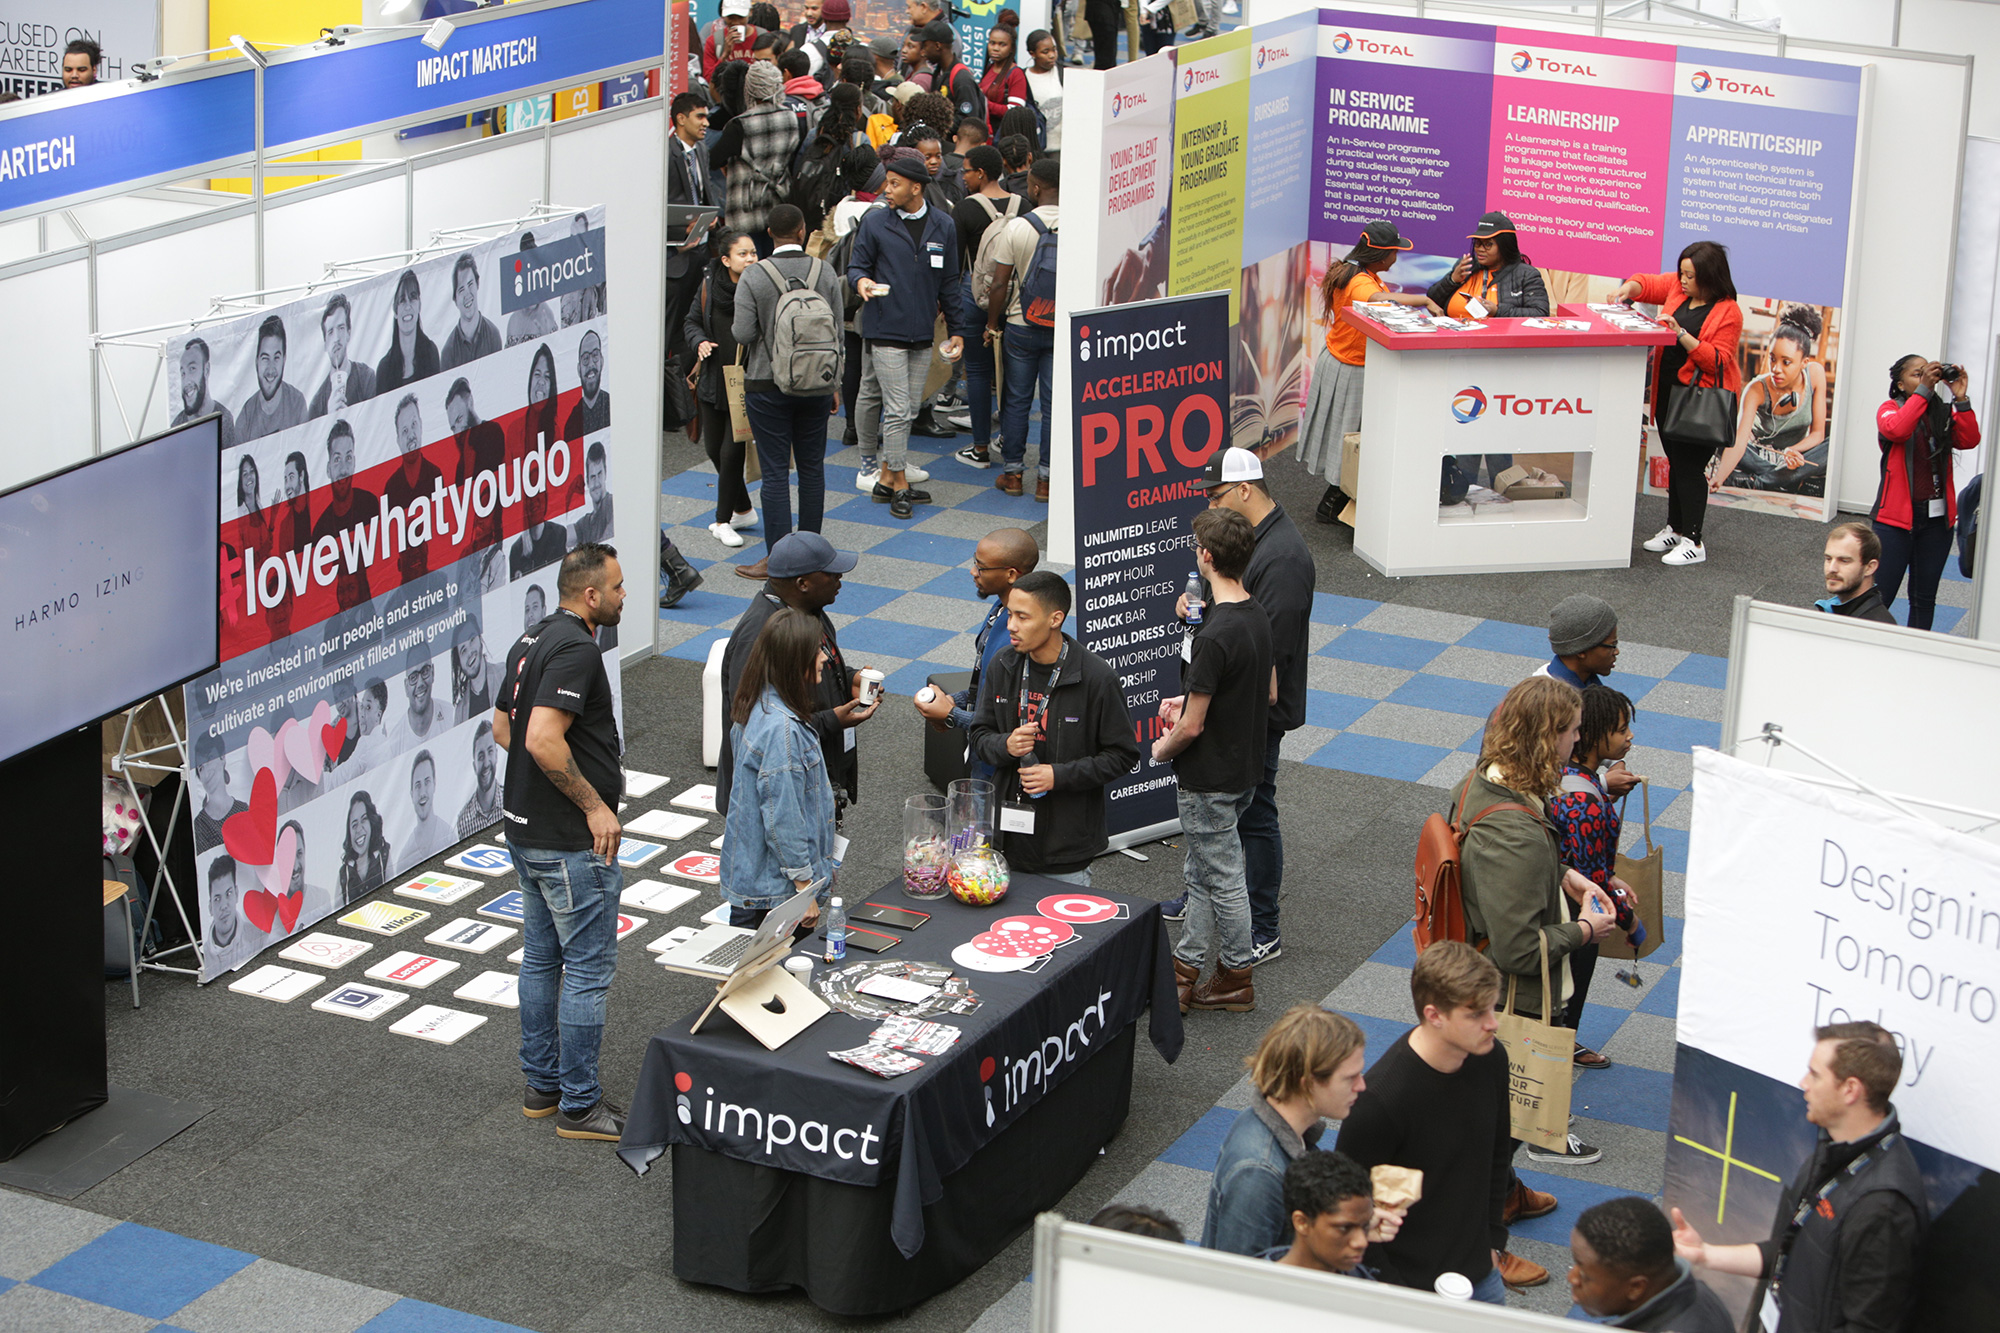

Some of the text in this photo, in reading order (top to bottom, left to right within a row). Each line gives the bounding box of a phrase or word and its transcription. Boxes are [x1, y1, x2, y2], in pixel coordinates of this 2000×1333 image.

[1267, 48, 1289, 62] TOTAL
[1356, 38, 1414, 58] TOTAL
[417, 36, 537, 88] IMPACT MARTECH
[1535, 57, 1597, 78] TOTAL
[1195, 69, 1220, 84] TOTAL
[1715, 77, 1775, 99] TOTAL
[1123, 92, 1147, 109] TOTAL
[1254, 96, 1290, 122] BURSARIES
[1329, 88, 1414, 113] IN SERVICE
[1328, 107, 1429, 135] PROGRAMME
[1507, 104, 1620, 133] LEARNERSHIP
[1181, 120, 1228, 150] INTERNSHIP &
[1341, 137, 1441, 155] In-Service programme
[1515, 134, 1627, 156] Learnership training
[1685, 125, 1823, 157] APPRENTICESHIP
[1110, 137, 1158, 170] YOUNG TALENT
[1181, 136, 1239, 171] YOUNG GRADUATE
[1336, 150, 1450, 167] practical work experience
[1504, 146, 1628, 165] programme that facilitates
[1699, 155, 1804, 175] Apprenticeship system
[1109, 159, 1156, 194] DEVELOPMENT
[1179, 161, 1228, 193] PROGRAMMES
[1325, 169, 1413, 186] two years theory.
[1326, 158, 1444, 178] during studies usually after
[1503, 165, 1642, 190] learning and work experience
[1504, 155, 1646, 179] the linkage between structured
[1325, 179, 1440, 199] Essential work experience
[1513, 179, 1617, 198] order for the individual
[1683, 178, 1821, 200] system that incorporates both
[1692, 168, 1823, 192] well known technical training
[1108, 181, 1155, 216] PROGRAMMES
[1324, 190, 1454, 212] that part the qualification
[1502, 190, 1651, 213] acquire registered qualification.
[1682, 188, 1810, 210] the theoretical and practical
[1323, 212, 1337, 220] the
[1324, 202, 1437, 221] and necessary achieve
[1680, 210, 1809, 233] trades achieve Artisan
[1681, 201, 1833, 225] components offered designated
[1508, 212, 1654, 236] combines theory and workplace
[1539, 227, 1556, 236] into
[1565, 230, 1621, 244] qualification.
[1680, 222, 1710, 232] status.
[526, 246, 593, 294] impact
[1096, 320, 1187, 360] impact
[1081, 360, 1223, 403] ACCELERATION
[1493, 394, 1592, 416] TOTAL
[1081, 393, 1224, 488] PRO
[1084, 516, 1178, 548] UNLIMITED LEAVE
[1084, 543, 1156, 569] BOTTOMLESS
[1085, 564, 1155, 591] HAPPY HOUR
[1085, 580, 1175, 612] GLOBAL OFFICES
[1086, 608, 1147, 633] SNACK BAR
[206, 582, 458, 704] We're invested in our people and strive to
[1086, 634, 1129, 653] CASUAL
[1131, 624, 1165, 644] DRESS
[208, 608, 467, 738] cultivate an environment filled with growth
[1120, 669, 1157, 689] ORSHIP
[1127, 689, 1160, 708] EKKER
[1110, 775, 1178, 801] CAREERS@IMPA
[477, 850, 507, 869] hp
[380, 911, 423, 932] Nikon
[453, 924, 486, 944] GROUPON
[330, 944, 366, 963] airbnb
[365, 991, 405, 1017] UBER
[1508, 1062, 1526, 1074] WN
[1509, 1092, 1539, 1109] TURE
[704, 1087, 880, 1165] impact
